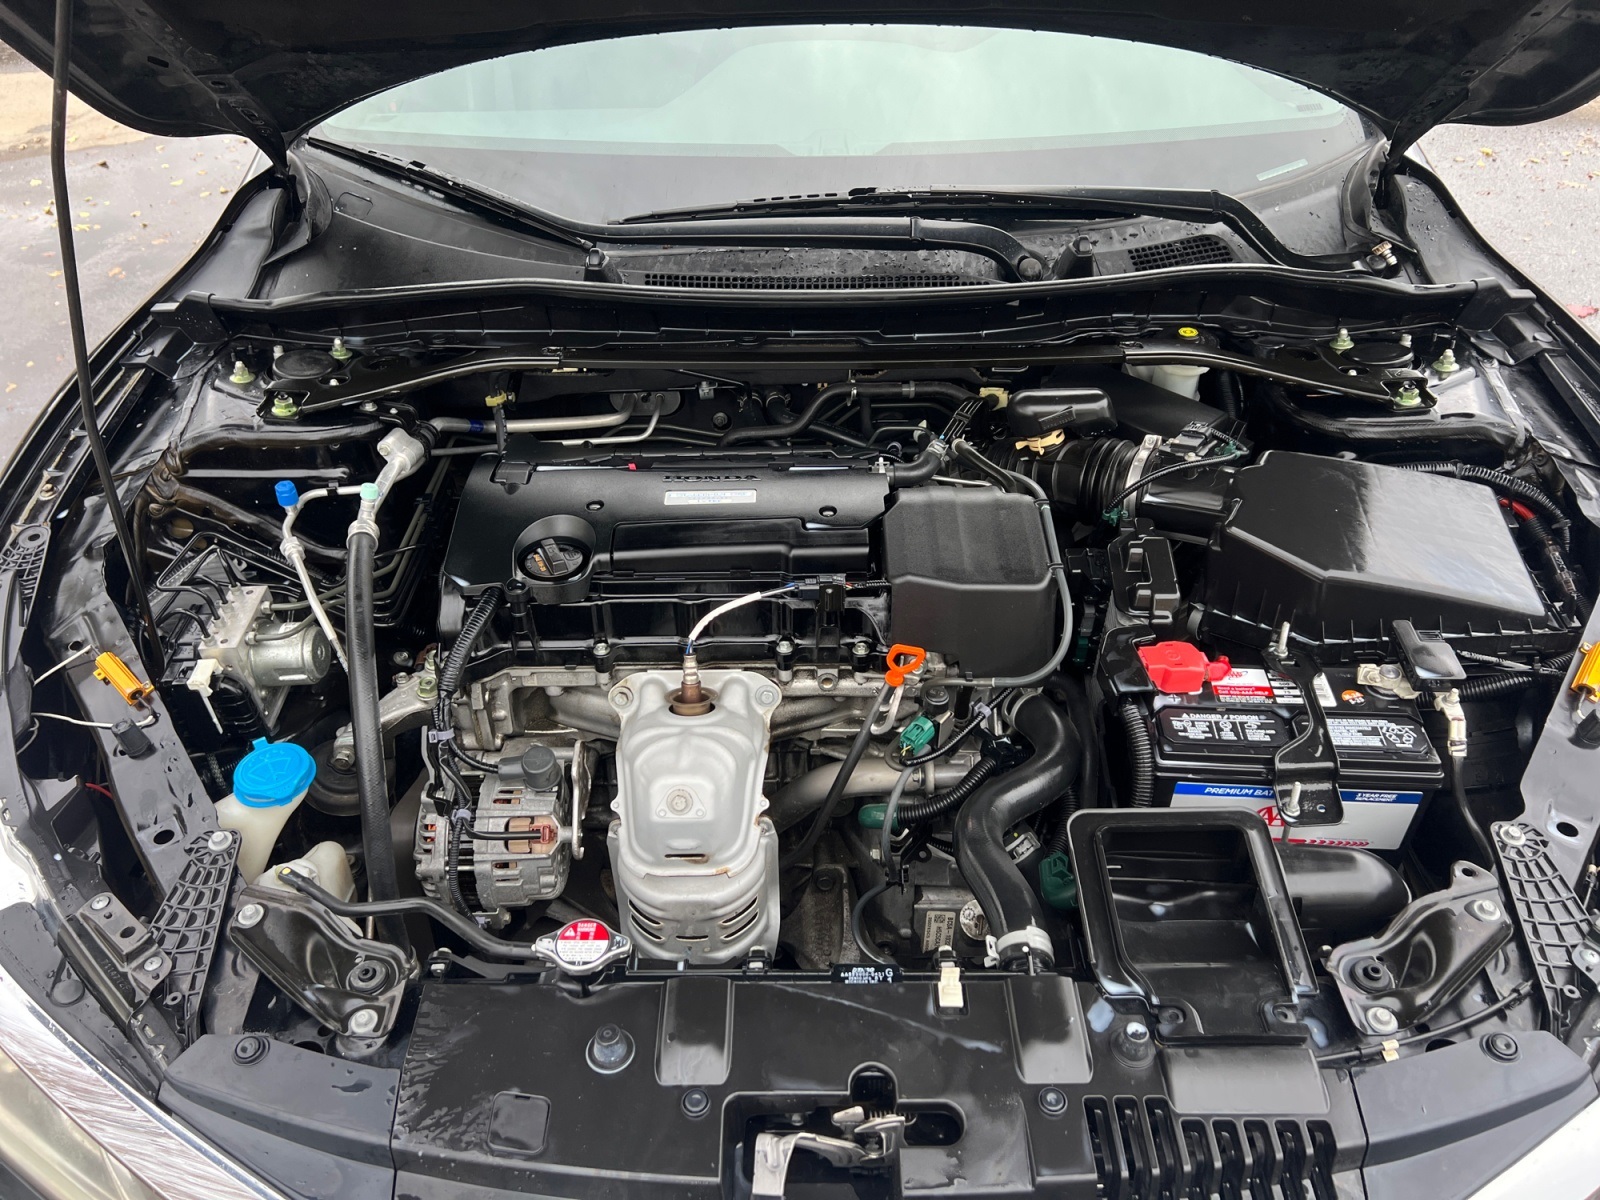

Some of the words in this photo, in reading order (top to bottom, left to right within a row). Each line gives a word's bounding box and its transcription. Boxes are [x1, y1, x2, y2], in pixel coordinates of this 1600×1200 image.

[1204, 787, 1253, 796] PREMIUM
[1254, 788, 1274, 797] BAT
[885, 968, 893, 977] G
